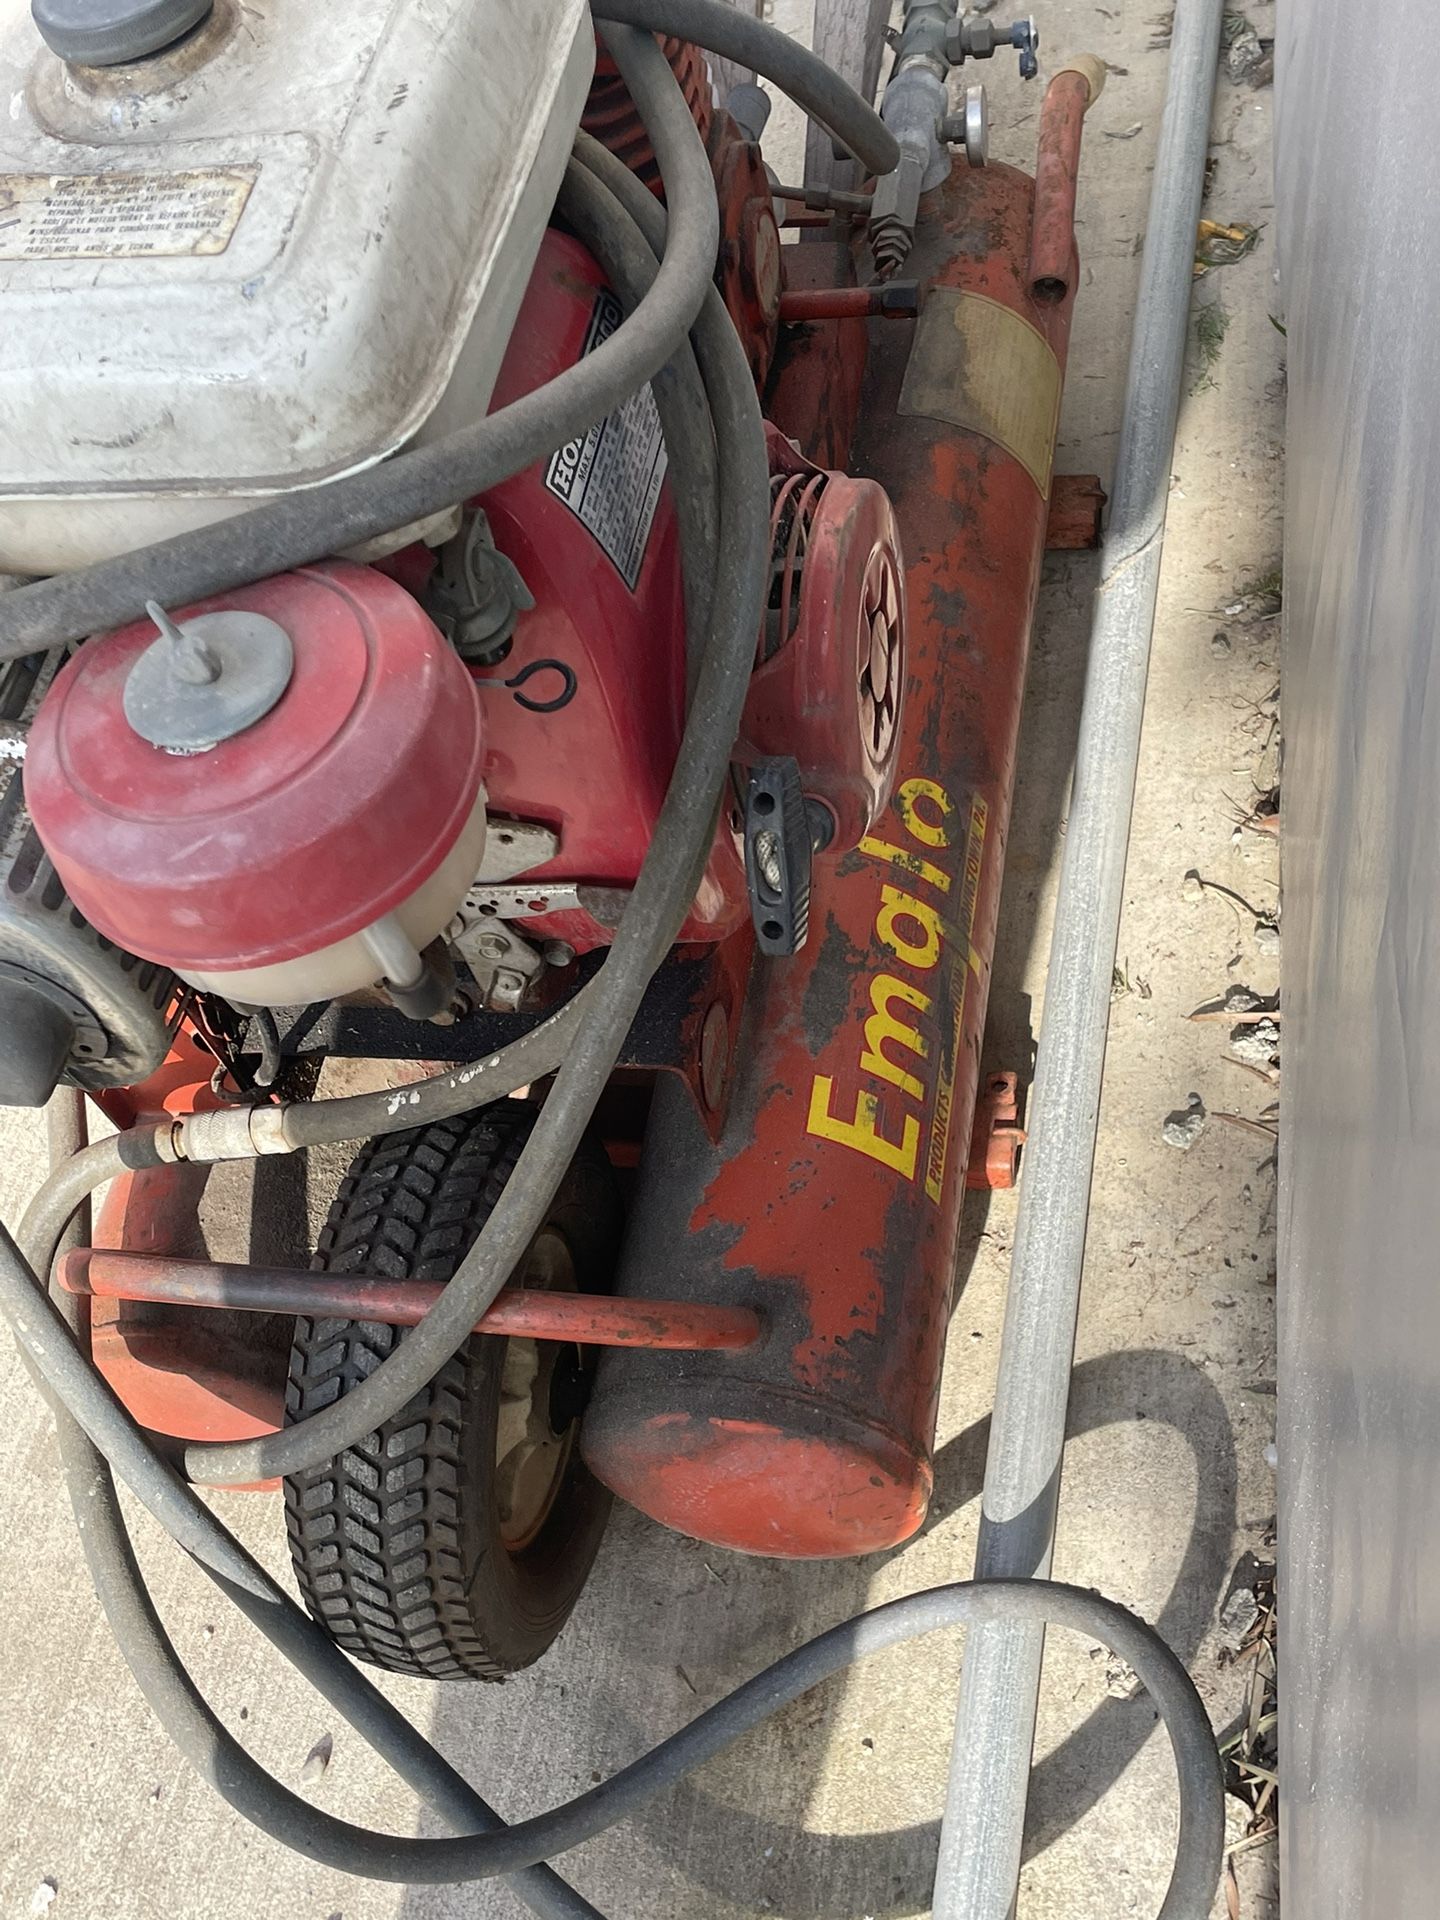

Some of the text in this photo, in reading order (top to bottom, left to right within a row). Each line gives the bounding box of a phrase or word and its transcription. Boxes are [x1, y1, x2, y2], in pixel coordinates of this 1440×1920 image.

[637, 512, 649, 545] MOTOR
[929, 1089, 950, 1186] PRODUCTS
[974, 804, 986, 829] PA.
